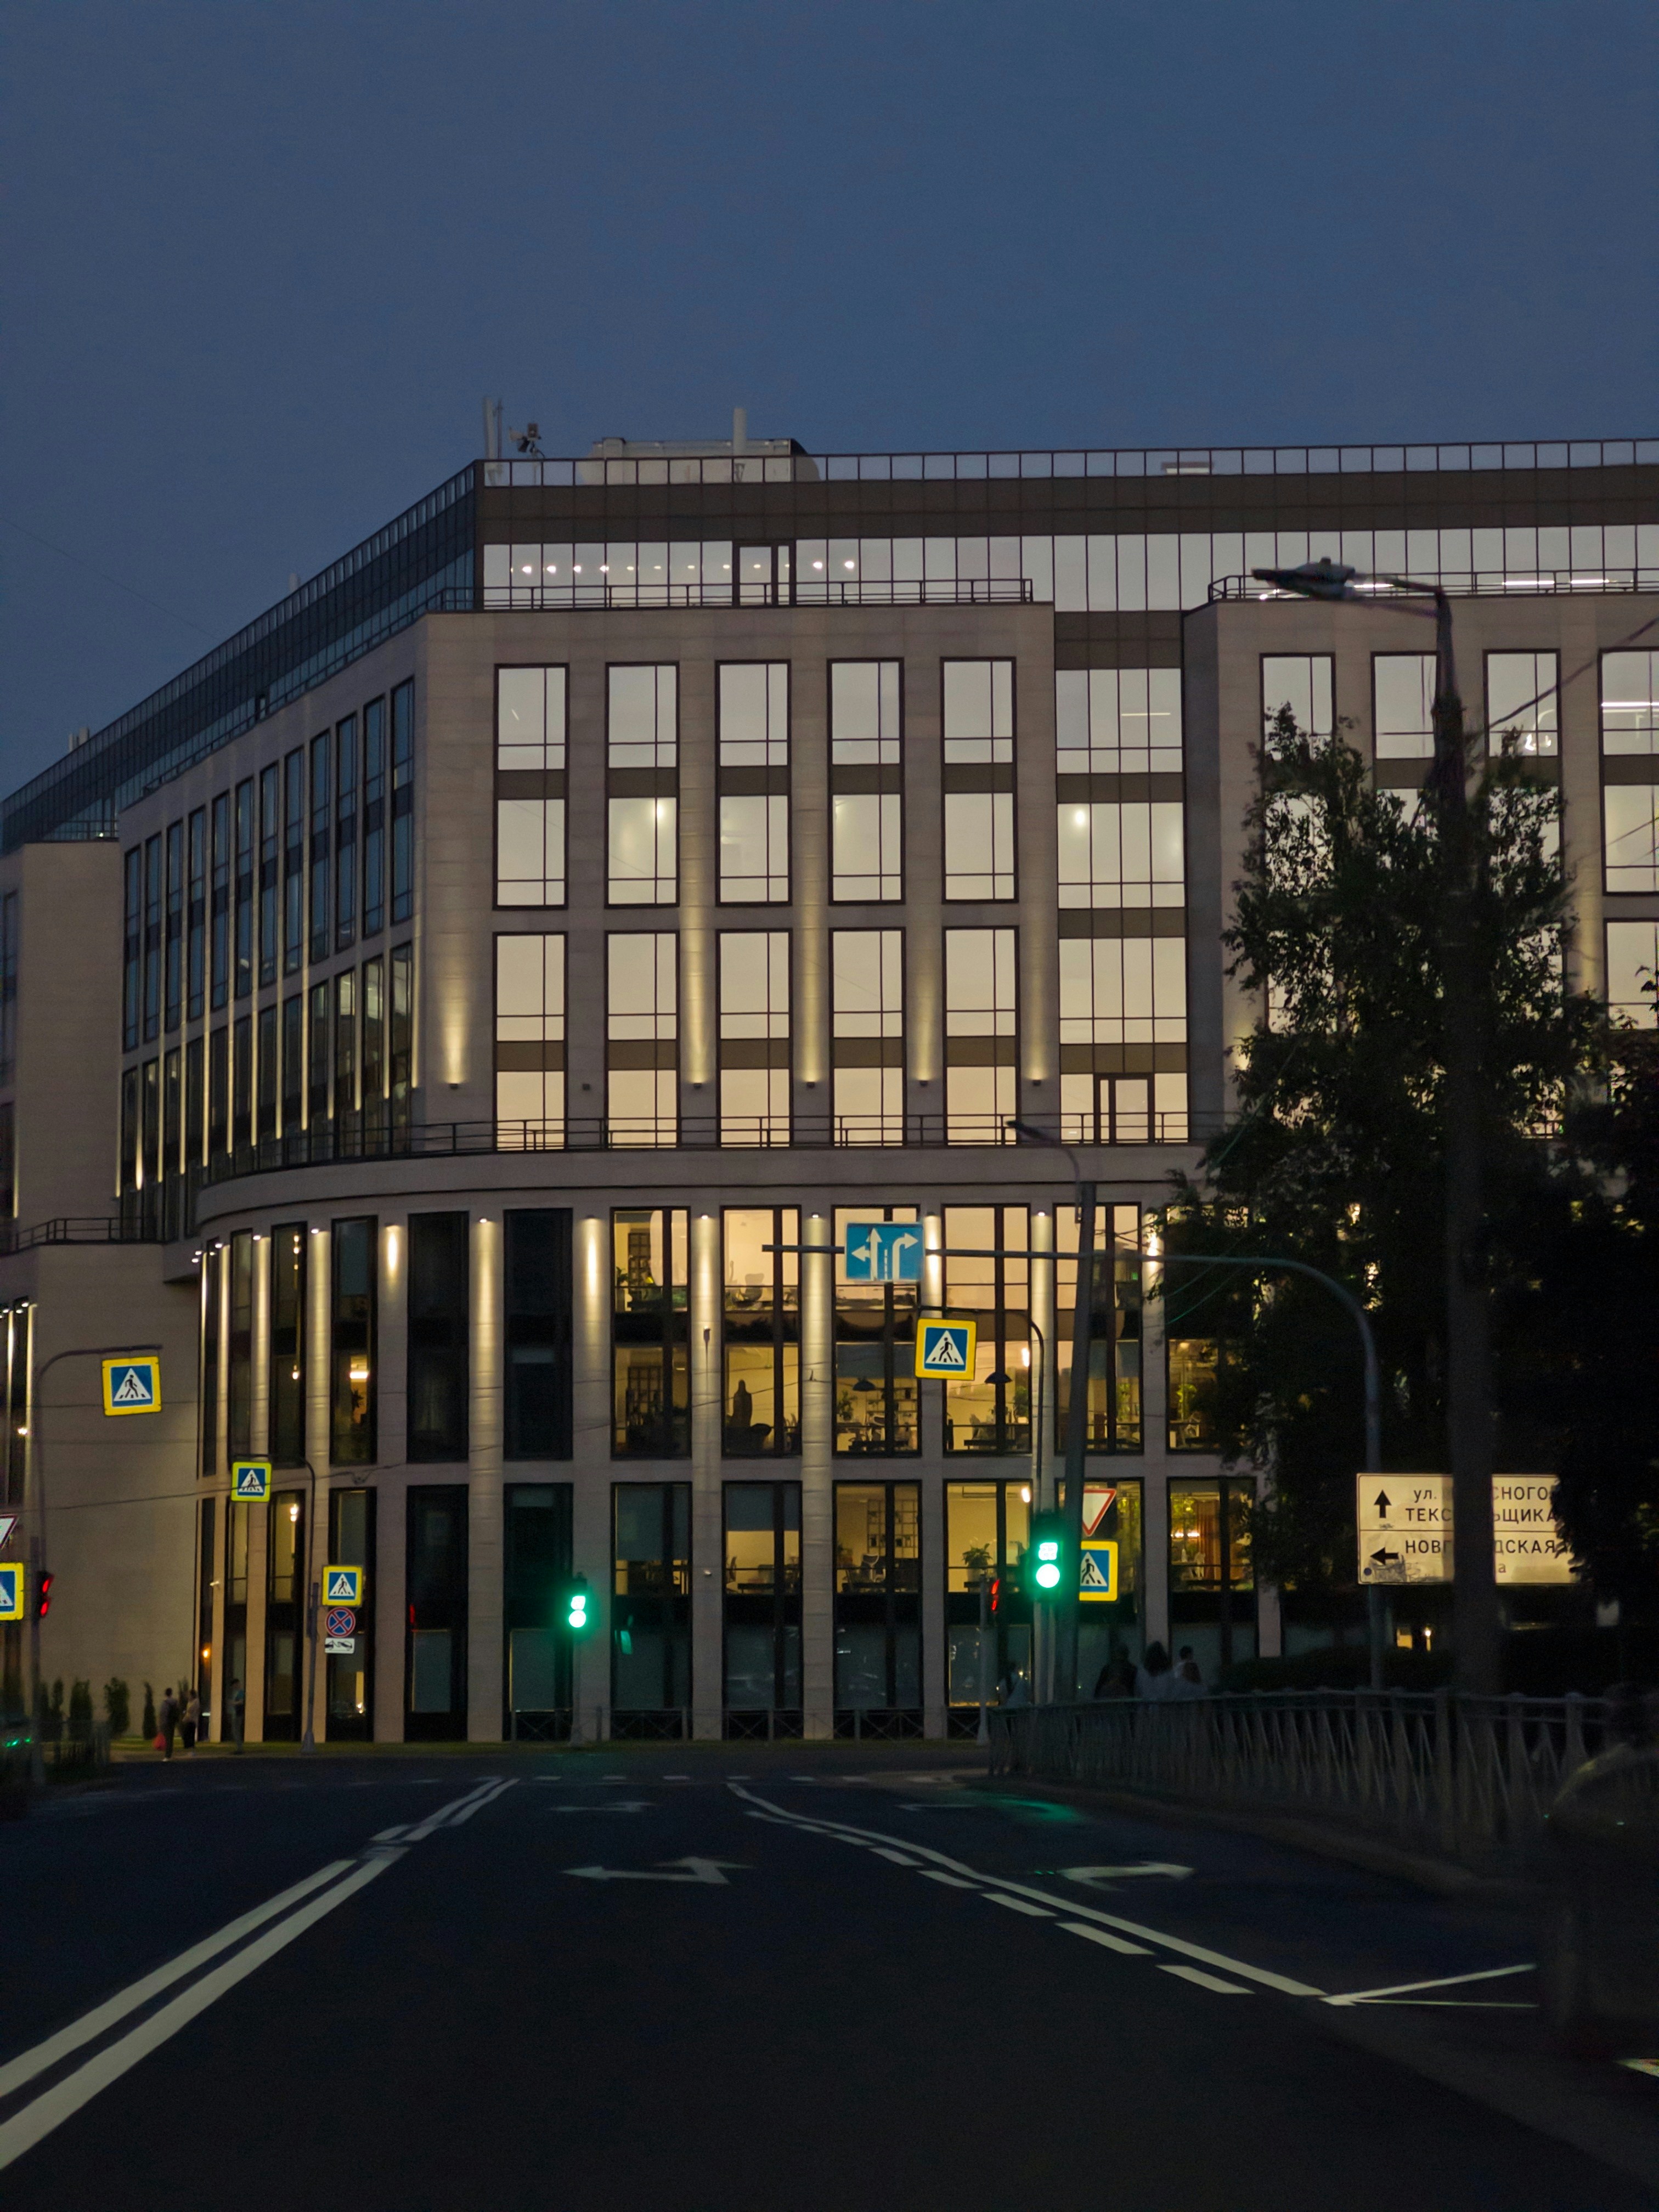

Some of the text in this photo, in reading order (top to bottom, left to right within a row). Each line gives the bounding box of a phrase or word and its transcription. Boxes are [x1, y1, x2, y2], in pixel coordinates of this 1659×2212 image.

[1413, 1489, 1437, 1503] ул.
[1405, 1508, 1556, 1524] ТЕКСЬЩИКА
[1405, 1539, 1556, 1555] НОВГДСКАЯ
